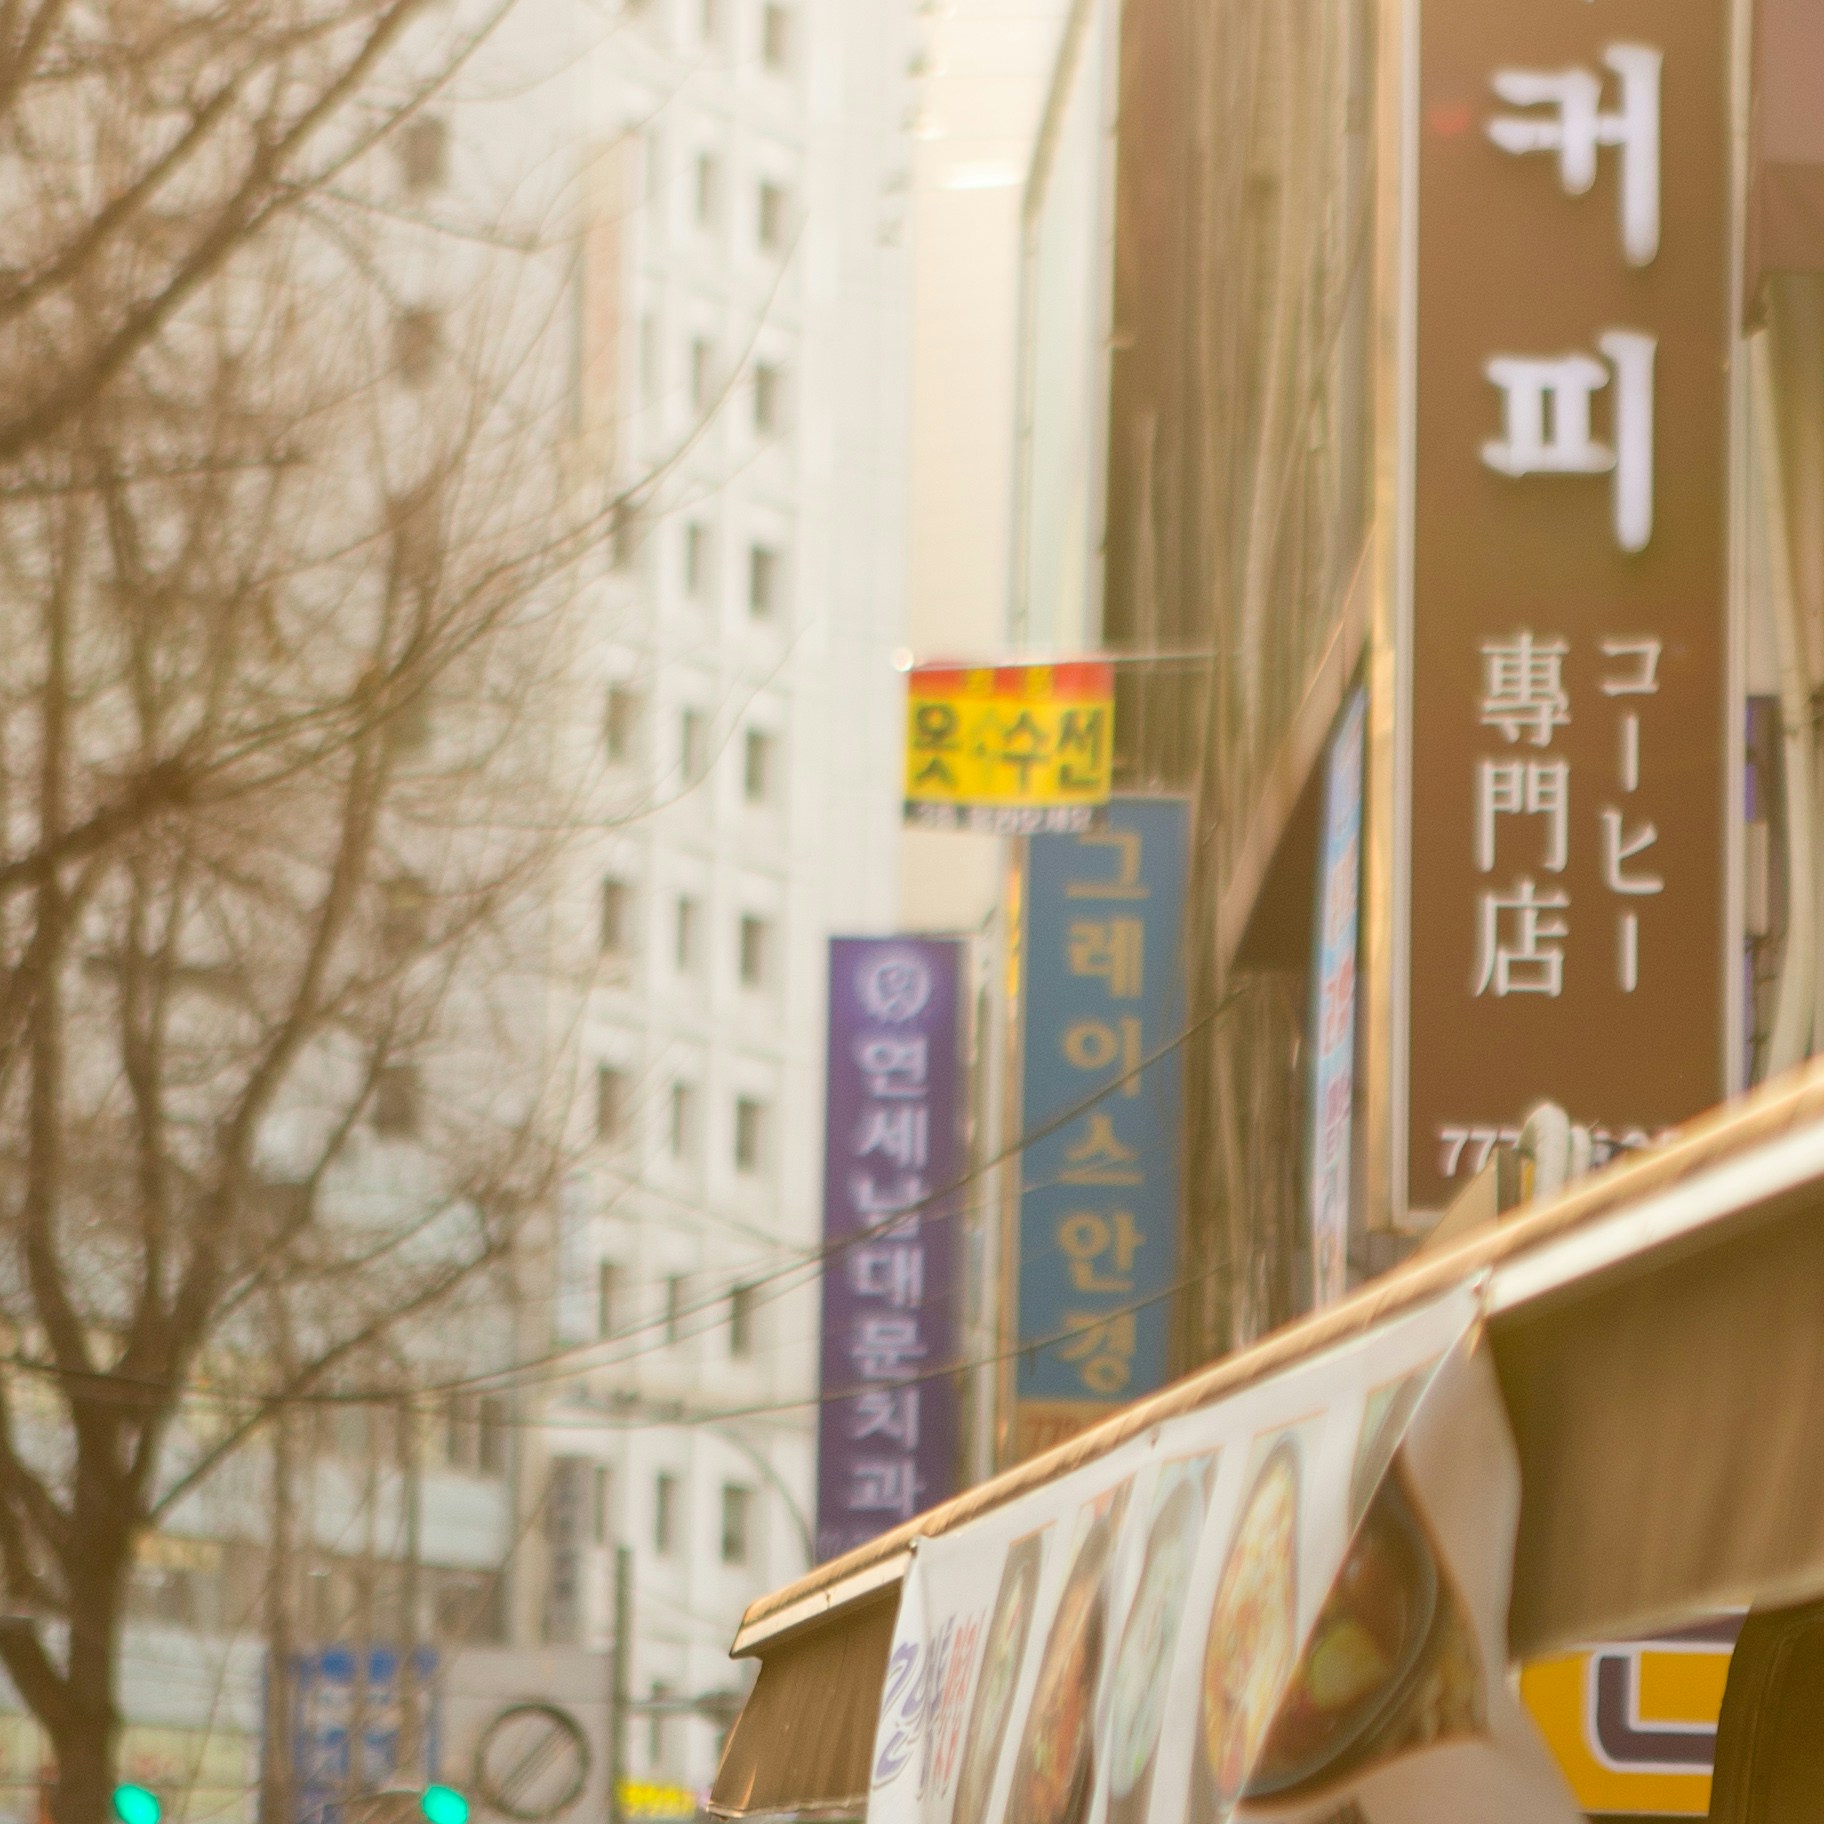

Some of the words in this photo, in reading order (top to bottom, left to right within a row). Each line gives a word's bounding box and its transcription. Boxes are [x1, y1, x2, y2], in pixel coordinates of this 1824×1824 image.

[1480, 39, 1662, 556] 커피
[1600, 636, 1665, 996] コーヒー
[1058, 829, 1148, 1396] 그레이스안경
